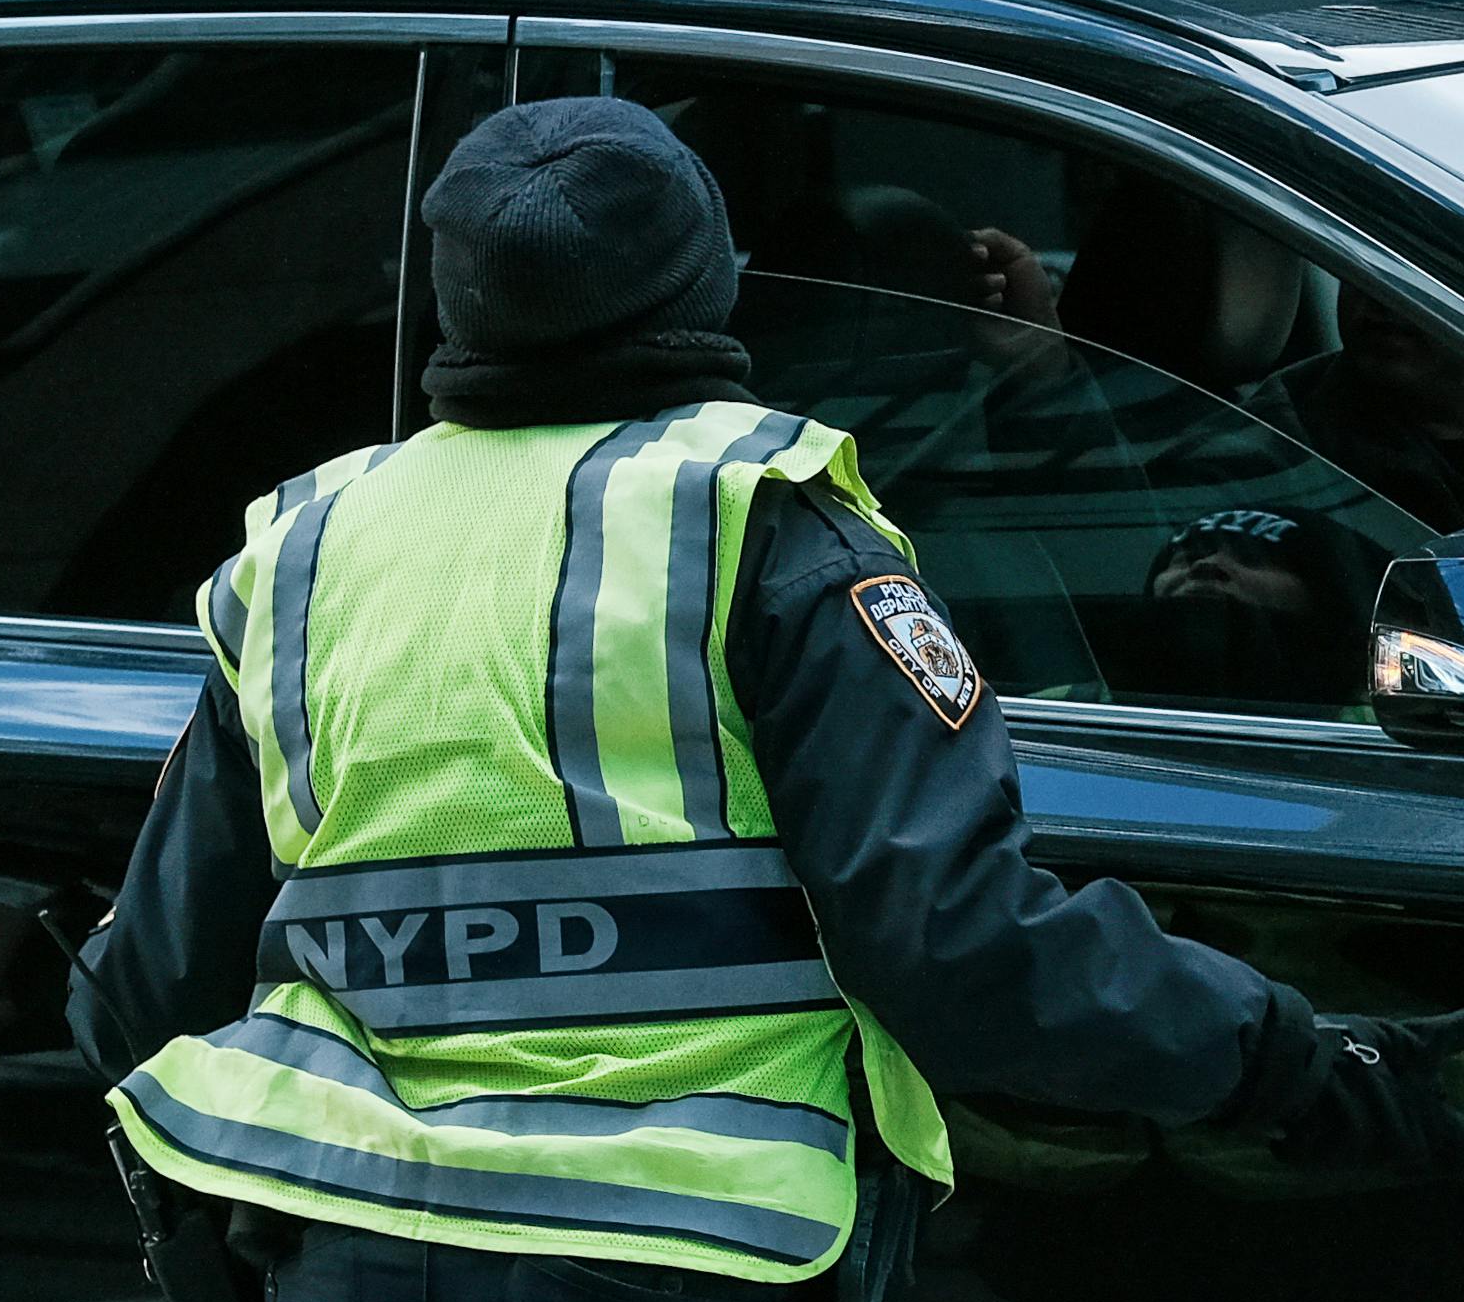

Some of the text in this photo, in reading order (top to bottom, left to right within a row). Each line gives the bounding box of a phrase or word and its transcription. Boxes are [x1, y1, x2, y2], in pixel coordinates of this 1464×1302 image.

[888, 638, 922, 673] CITY
[922, 677, 942, 700] OF
[285, 902, 619, 989] NYPD
